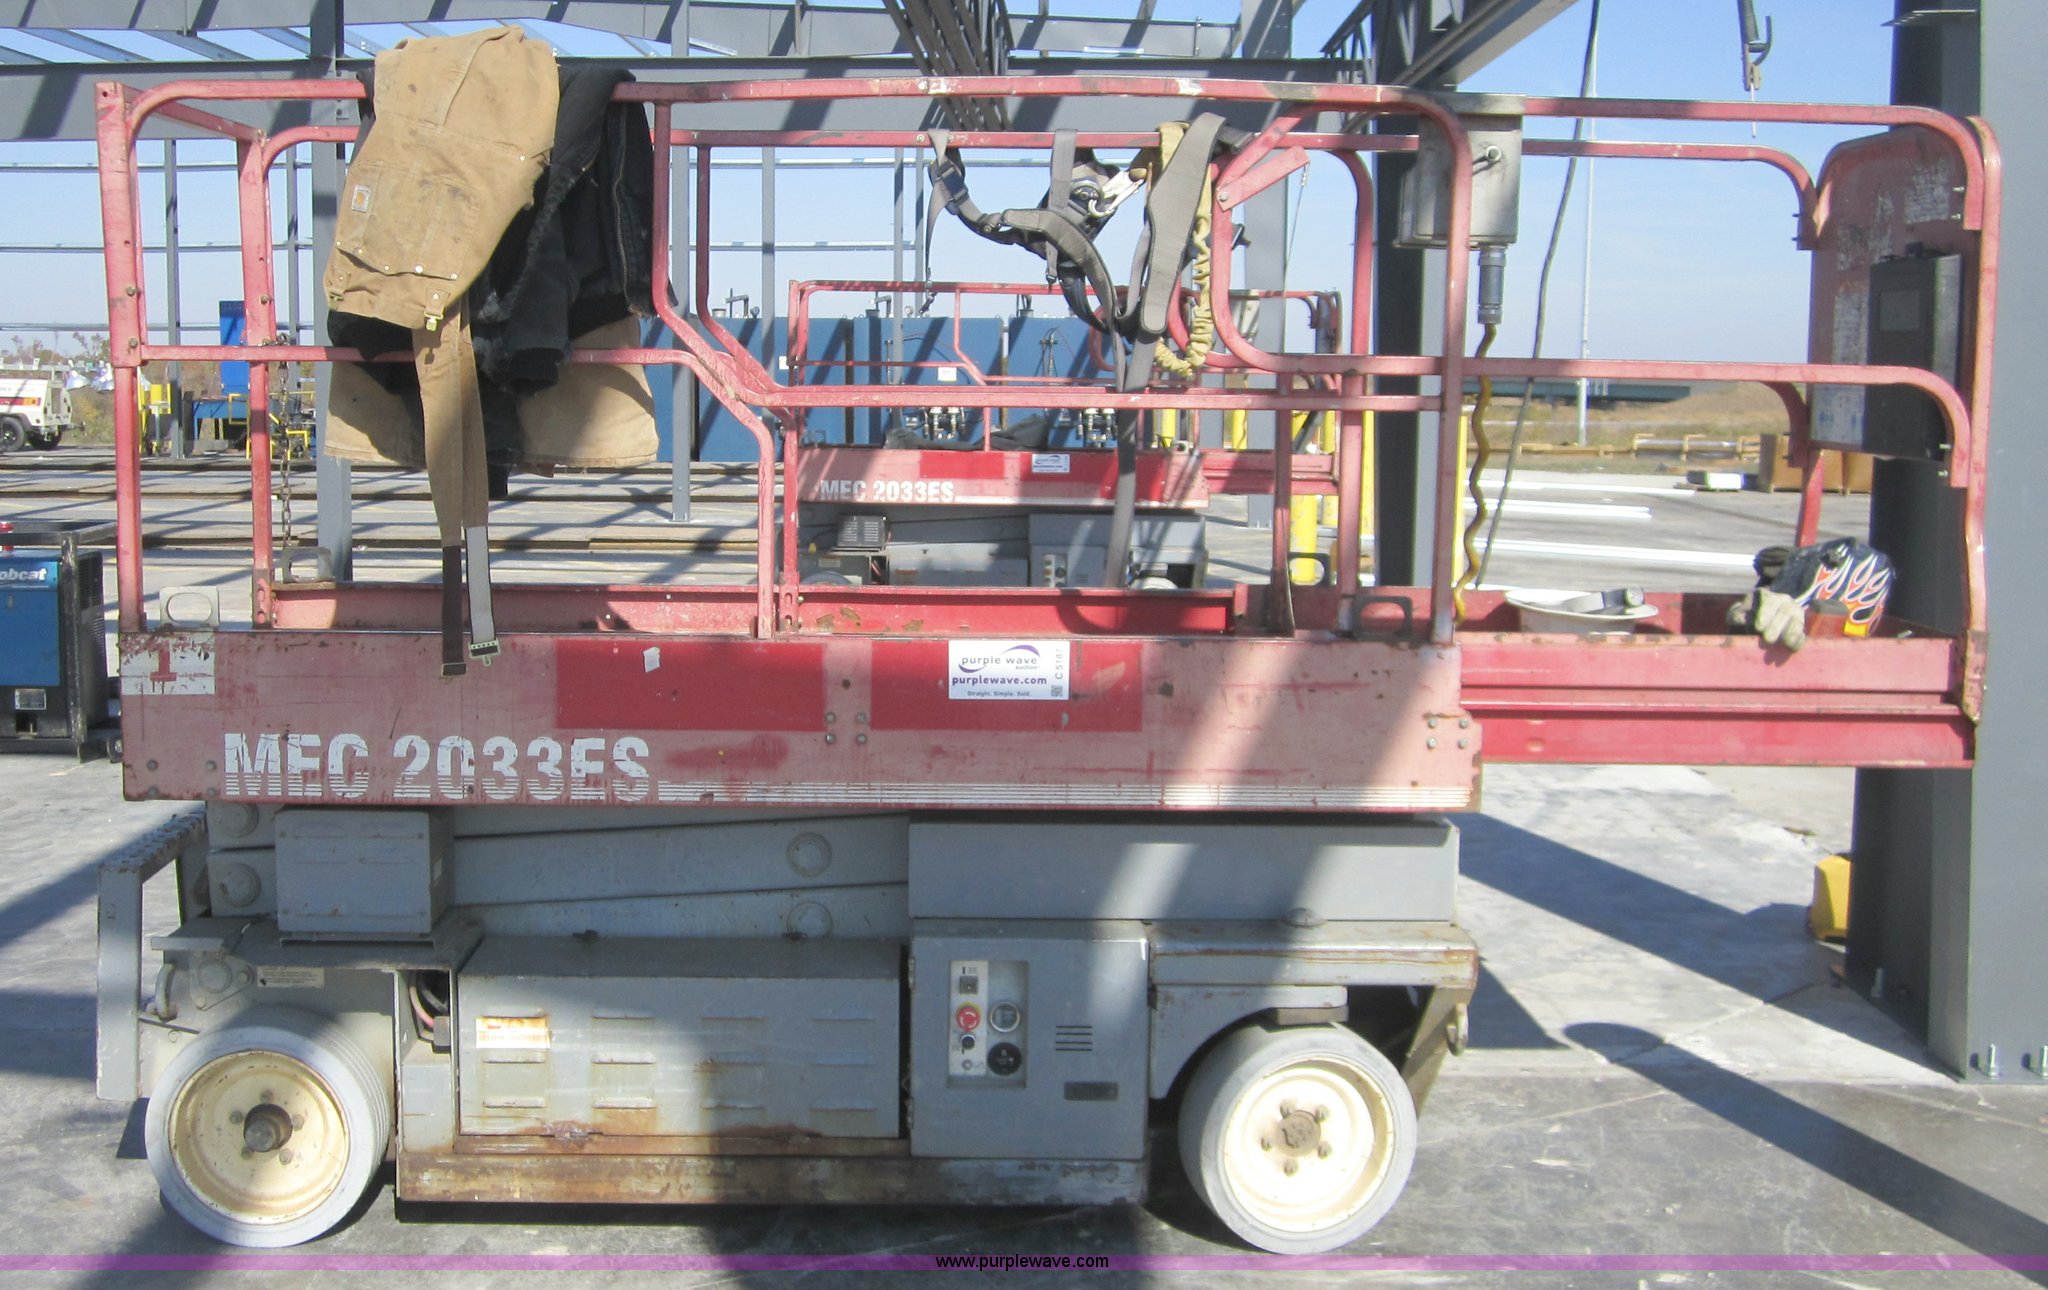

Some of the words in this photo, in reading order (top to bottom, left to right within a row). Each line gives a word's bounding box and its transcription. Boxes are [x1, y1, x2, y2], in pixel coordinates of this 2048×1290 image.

[821, 480, 866, 502] MEC
[872, 481, 954, 502] 2033ES
[0, 568, 47, 581] obcat
[961, 655, 1001, 667] purple
[1006, 657, 1038, 665] wave
[952, 675, 1047, 686] purplewave.com
[224, 733, 369, 798] MEC
[393, 735, 650, 802] 2033ES
